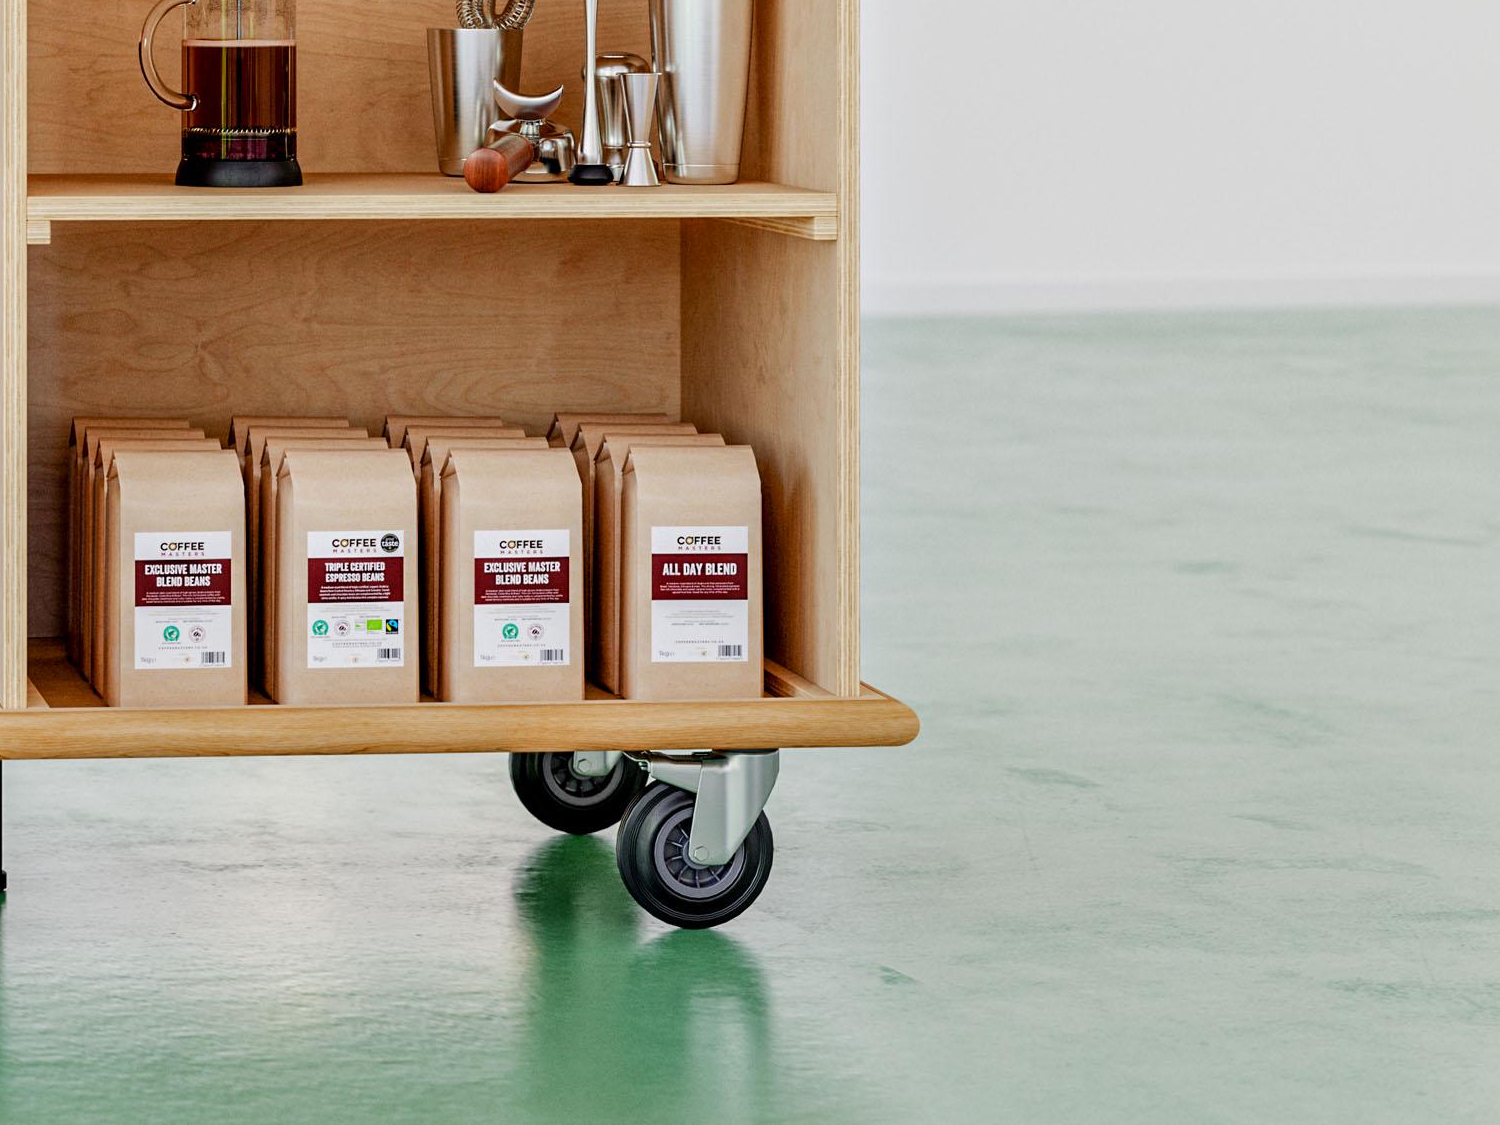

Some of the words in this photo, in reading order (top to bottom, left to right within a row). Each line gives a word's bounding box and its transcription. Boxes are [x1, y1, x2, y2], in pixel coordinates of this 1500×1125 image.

[332, 539, 376, 547] COFFEE
[500, 540, 543, 549] COFFEE
[677, 536, 721, 545] COFFEE
[160, 542, 204, 551] COFFEE
[144, 564, 188, 575] EXCLUSIVE
[189, 563, 222, 574] MASTER
[324, 562, 349, 572] TRIPLE
[350, 562, 385, 571] CERTIFIED
[484, 562, 527, 573] EXCLUSIVE
[528, 561, 561, 572] MASTER
[662, 563, 681, 576] ALL
[683, 563, 703, 575] DAY
[705, 563, 737, 575] BLEND
[156, 576, 182, 587] BLEND
[184, 576, 211, 586] BEANS
[325, 573, 361, 582] ESPRESSO
[361, 572, 385, 582] BEANS
[495, 574, 521, 585] BLEND
[523, 574, 549, 584] BEANS
